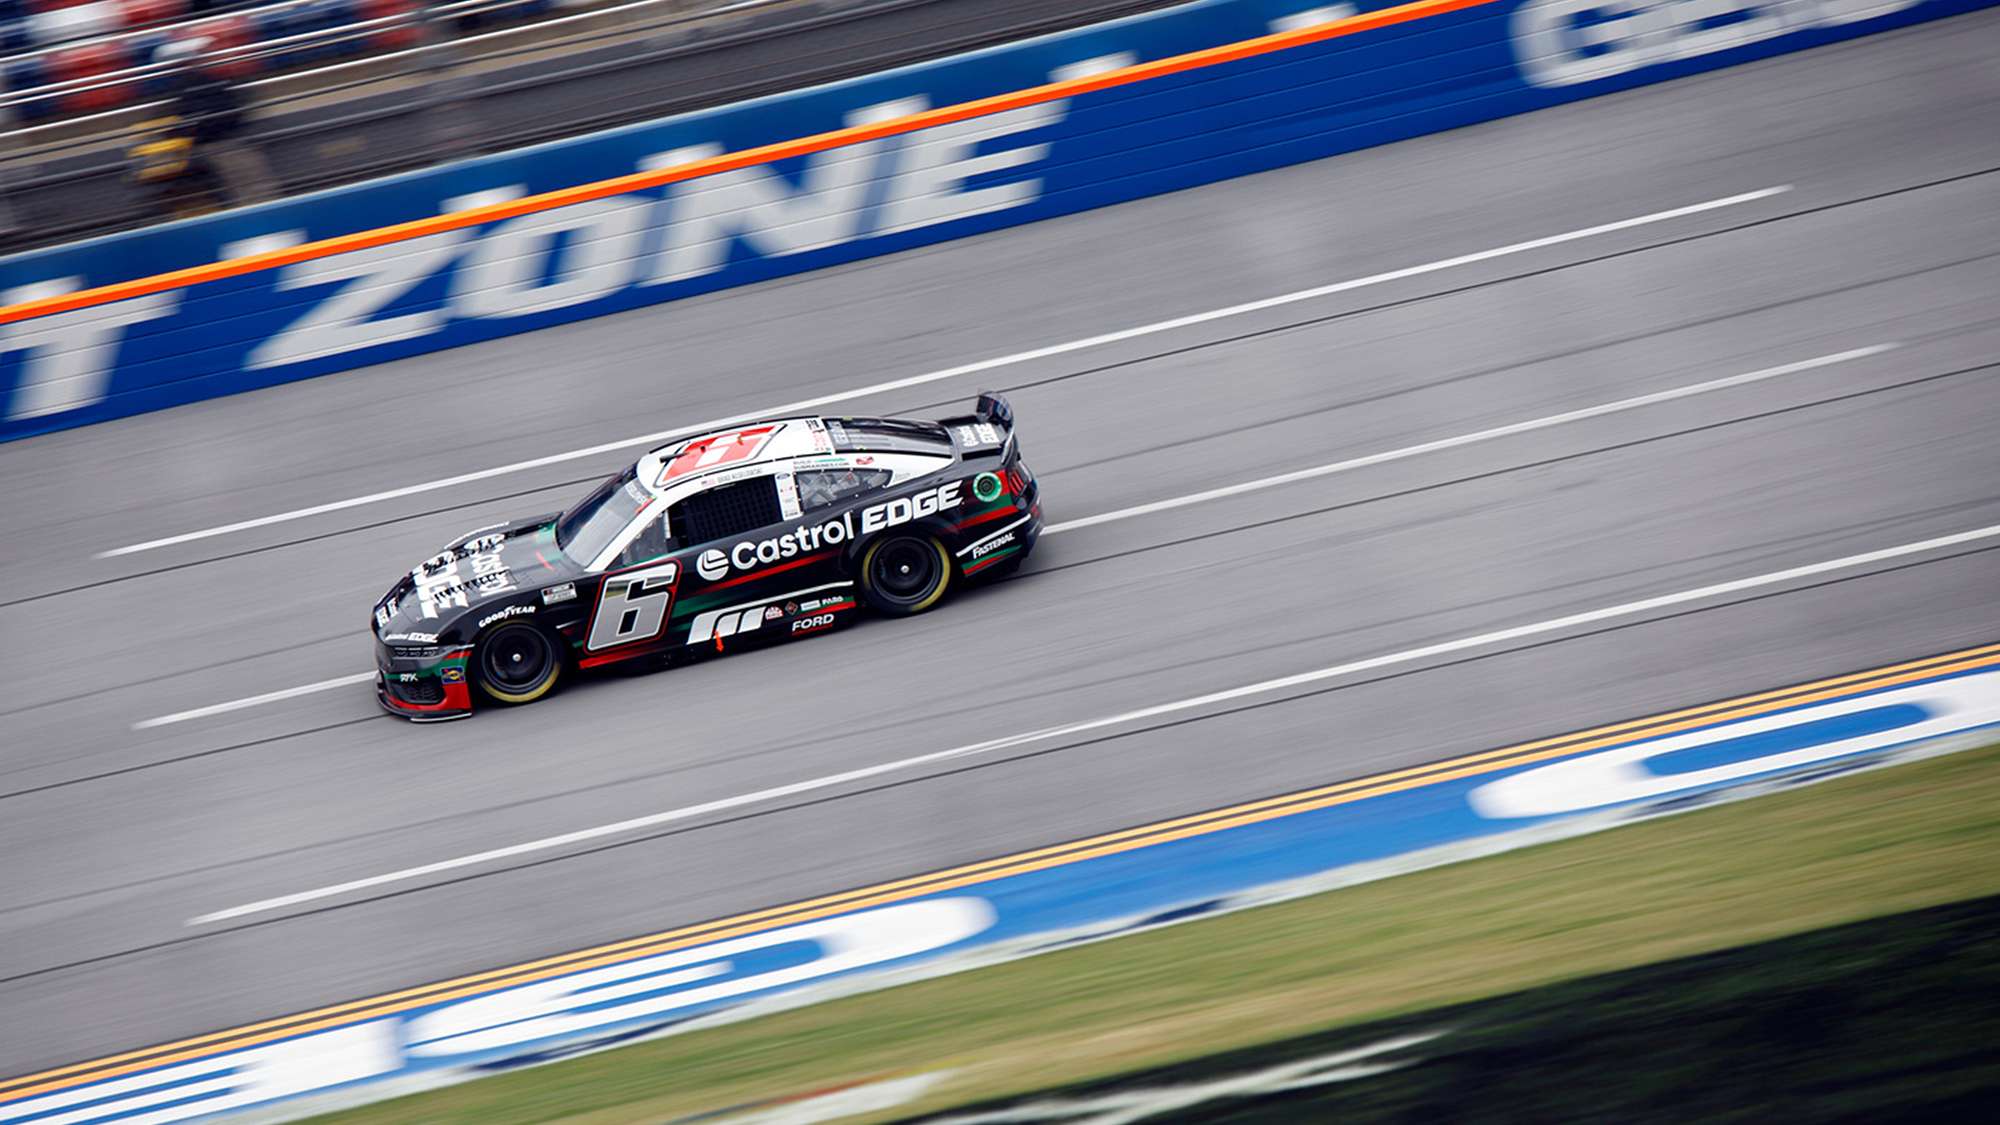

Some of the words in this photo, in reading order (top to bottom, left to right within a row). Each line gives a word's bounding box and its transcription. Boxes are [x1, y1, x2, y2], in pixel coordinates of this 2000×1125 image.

[243, 100, 1071, 371] ZONE
[732, 511, 855, 570] Castrol
[862, 479, 964, 534] EDGE
[478, 605, 536, 628] GOODYEAR
[587, 562, 678, 651] 6
[792, 614, 834, 632] FORD
